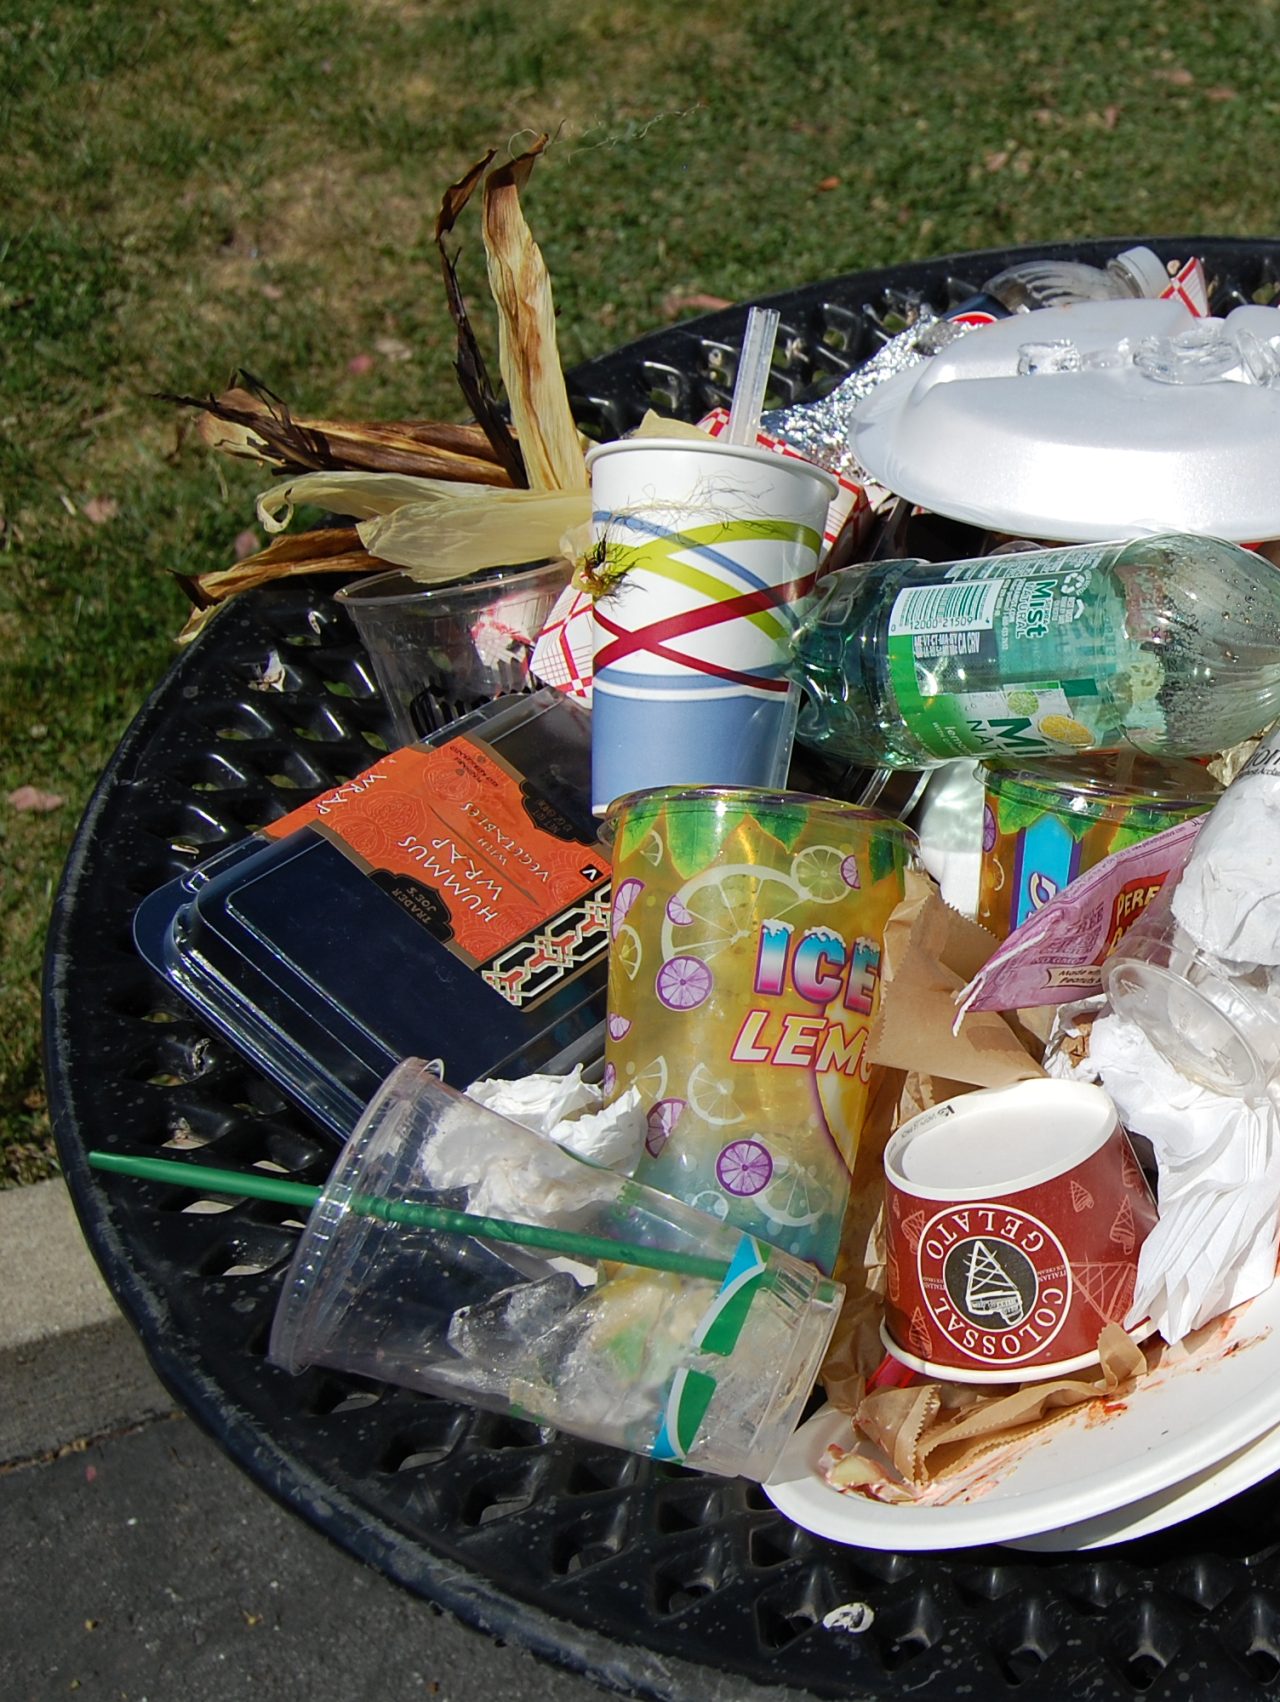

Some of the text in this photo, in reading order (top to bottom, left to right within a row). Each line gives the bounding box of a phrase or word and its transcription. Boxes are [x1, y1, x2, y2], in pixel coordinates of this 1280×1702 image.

[1016, 582, 1035, 639] NATURAL
[1026, 580, 1057, 637] Mist
[315, 773, 388, 815] WRAP
[460, 801, 549, 883] VEGETABLES
[477, 838, 507, 866] WITH
[397, 835, 499, 923] HUMMUS
[431, 839, 503, 901] WRAP
[391, 887, 433, 925] TRADER
[406, 886, 437, 913] JOE'S
[1116, 886, 1161, 926] PERF
[926, 1209, 1045, 1260] GELATO
[1037, 1270, 1067, 1283] ITALIAN
[933, 1287, 1065, 1356] COLOSSAL
